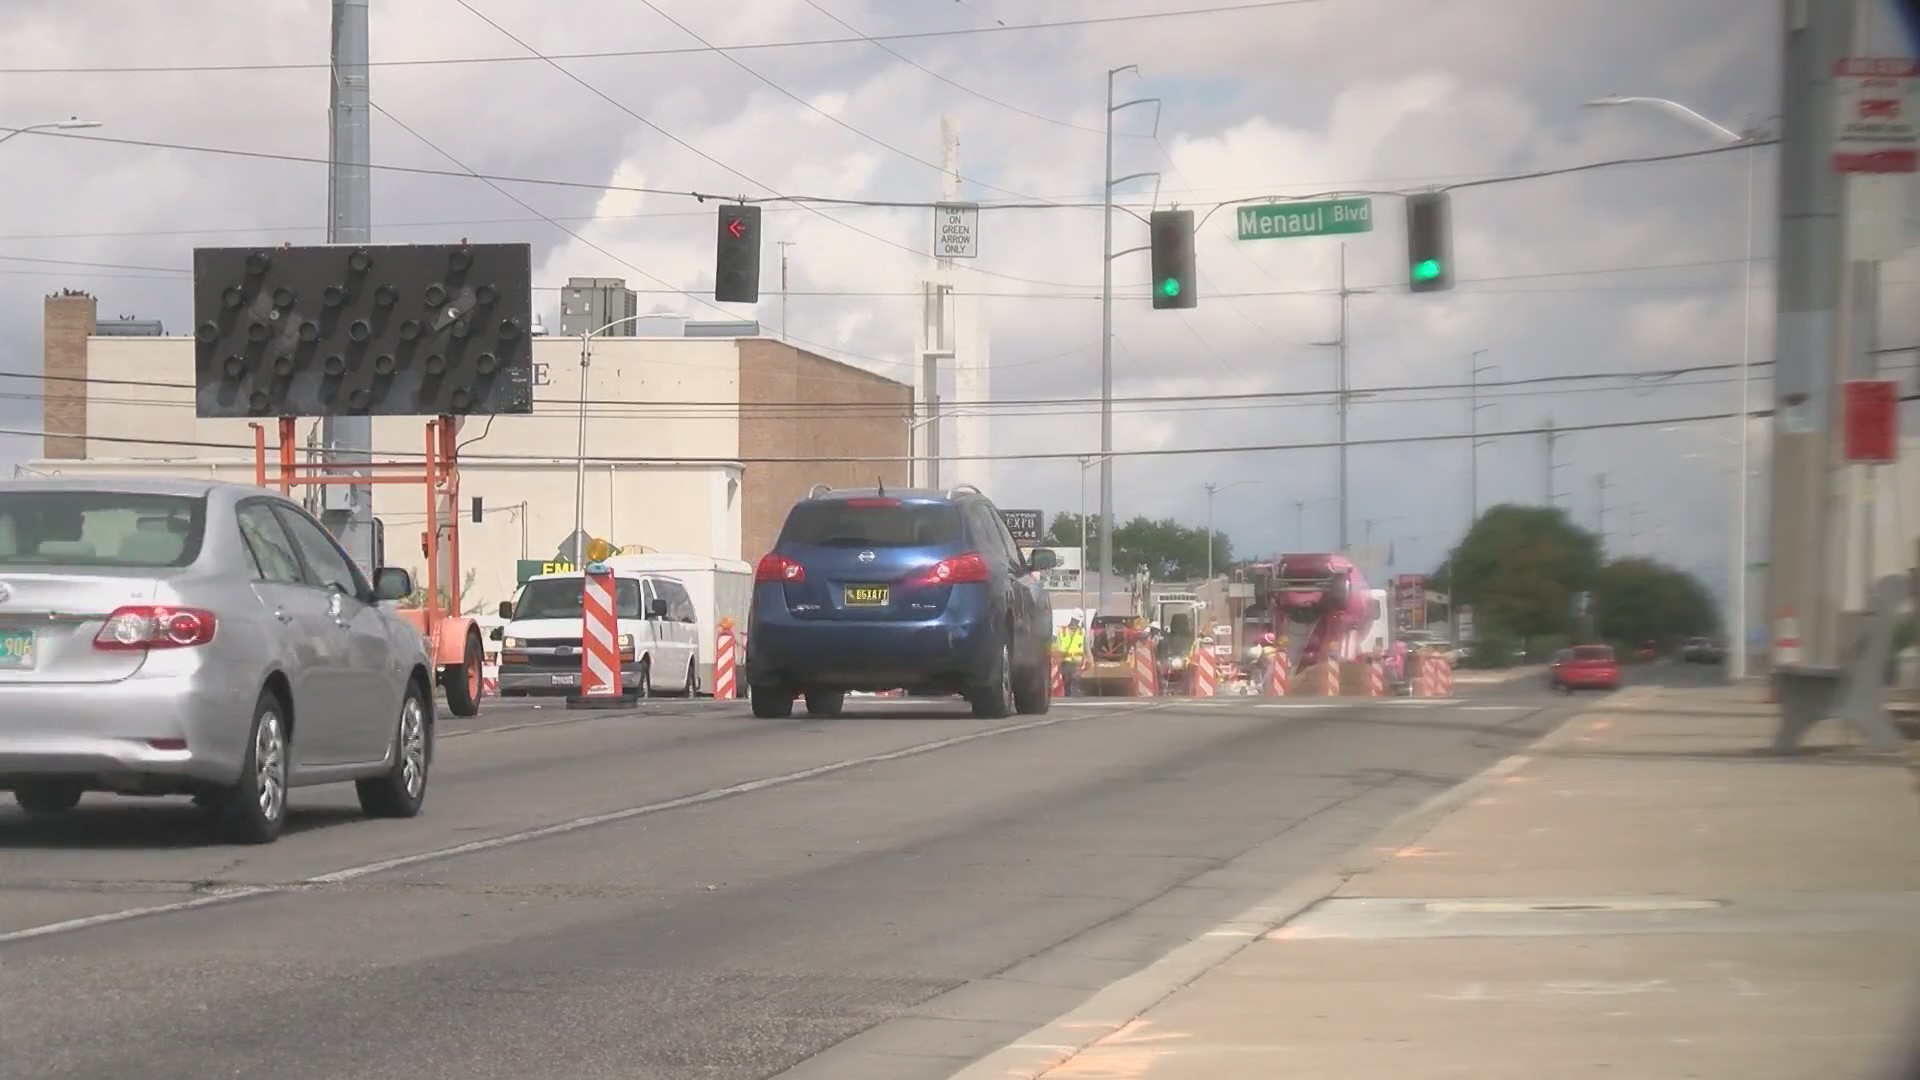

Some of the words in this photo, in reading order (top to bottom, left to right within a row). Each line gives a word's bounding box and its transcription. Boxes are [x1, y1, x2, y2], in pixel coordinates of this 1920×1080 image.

[949, 215, 961, 224] ON
[1239, 207, 1324, 235] Menaul
[1334, 203, 1369, 222] Blvd
[942, 225, 970, 234] GREEN
[940, 234, 971, 244] ARROW
[944, 244, 966, 254] ONLY
[1006, 518, 1035, 528] EXPO
